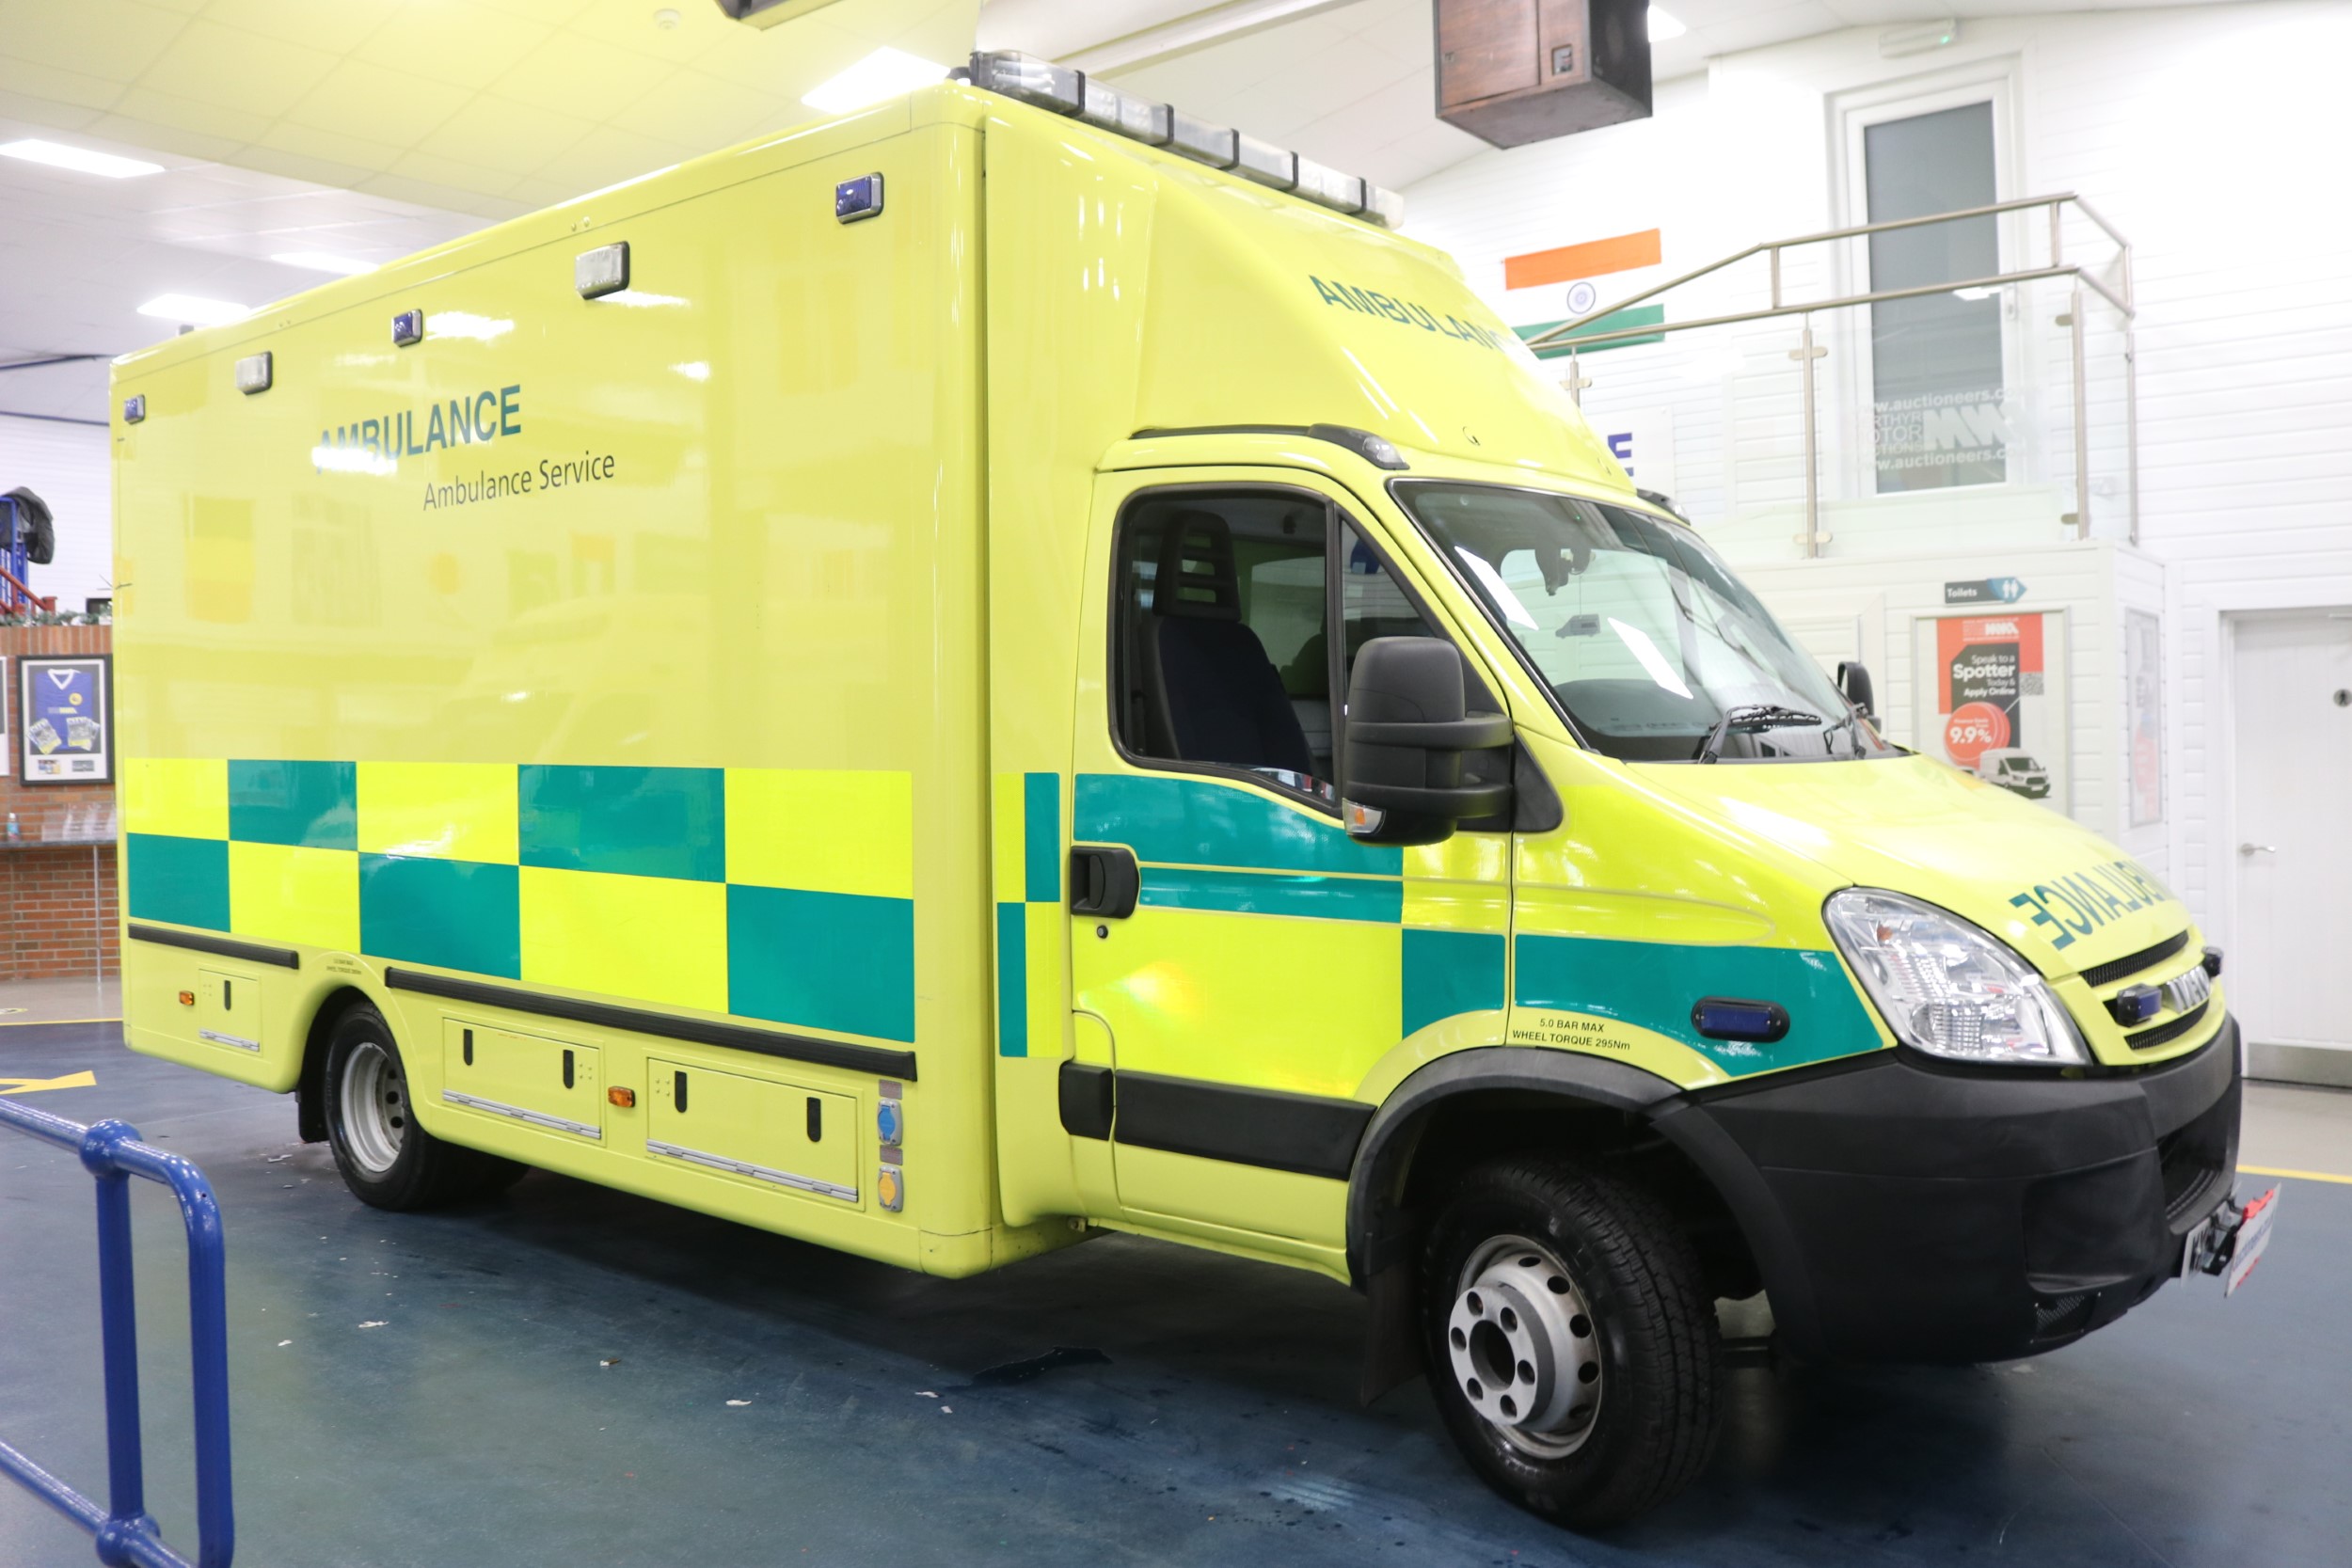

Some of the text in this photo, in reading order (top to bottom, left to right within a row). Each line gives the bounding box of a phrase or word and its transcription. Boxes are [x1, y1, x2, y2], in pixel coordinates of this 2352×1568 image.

[1308, 275, 1515, 354] AMBULANC
[423, 451, 615, 511] Ambulance Service
[1947, 587, 1978, 598] Toilets
[1971, 655, 1997, 665] Speak
[1998, 655, 2009, 663] to
[1952, 663, 2016, 683] Spotter
[1963, 688, 2016, 698] Apply Online
[1949, 726, 1993, 744] 9.9%
[1539, 1018, 1605, 1033] 5.0 BAR MAX
[1512, 1029, 1630, 1051] WHEEL TORQUE 295Nm
